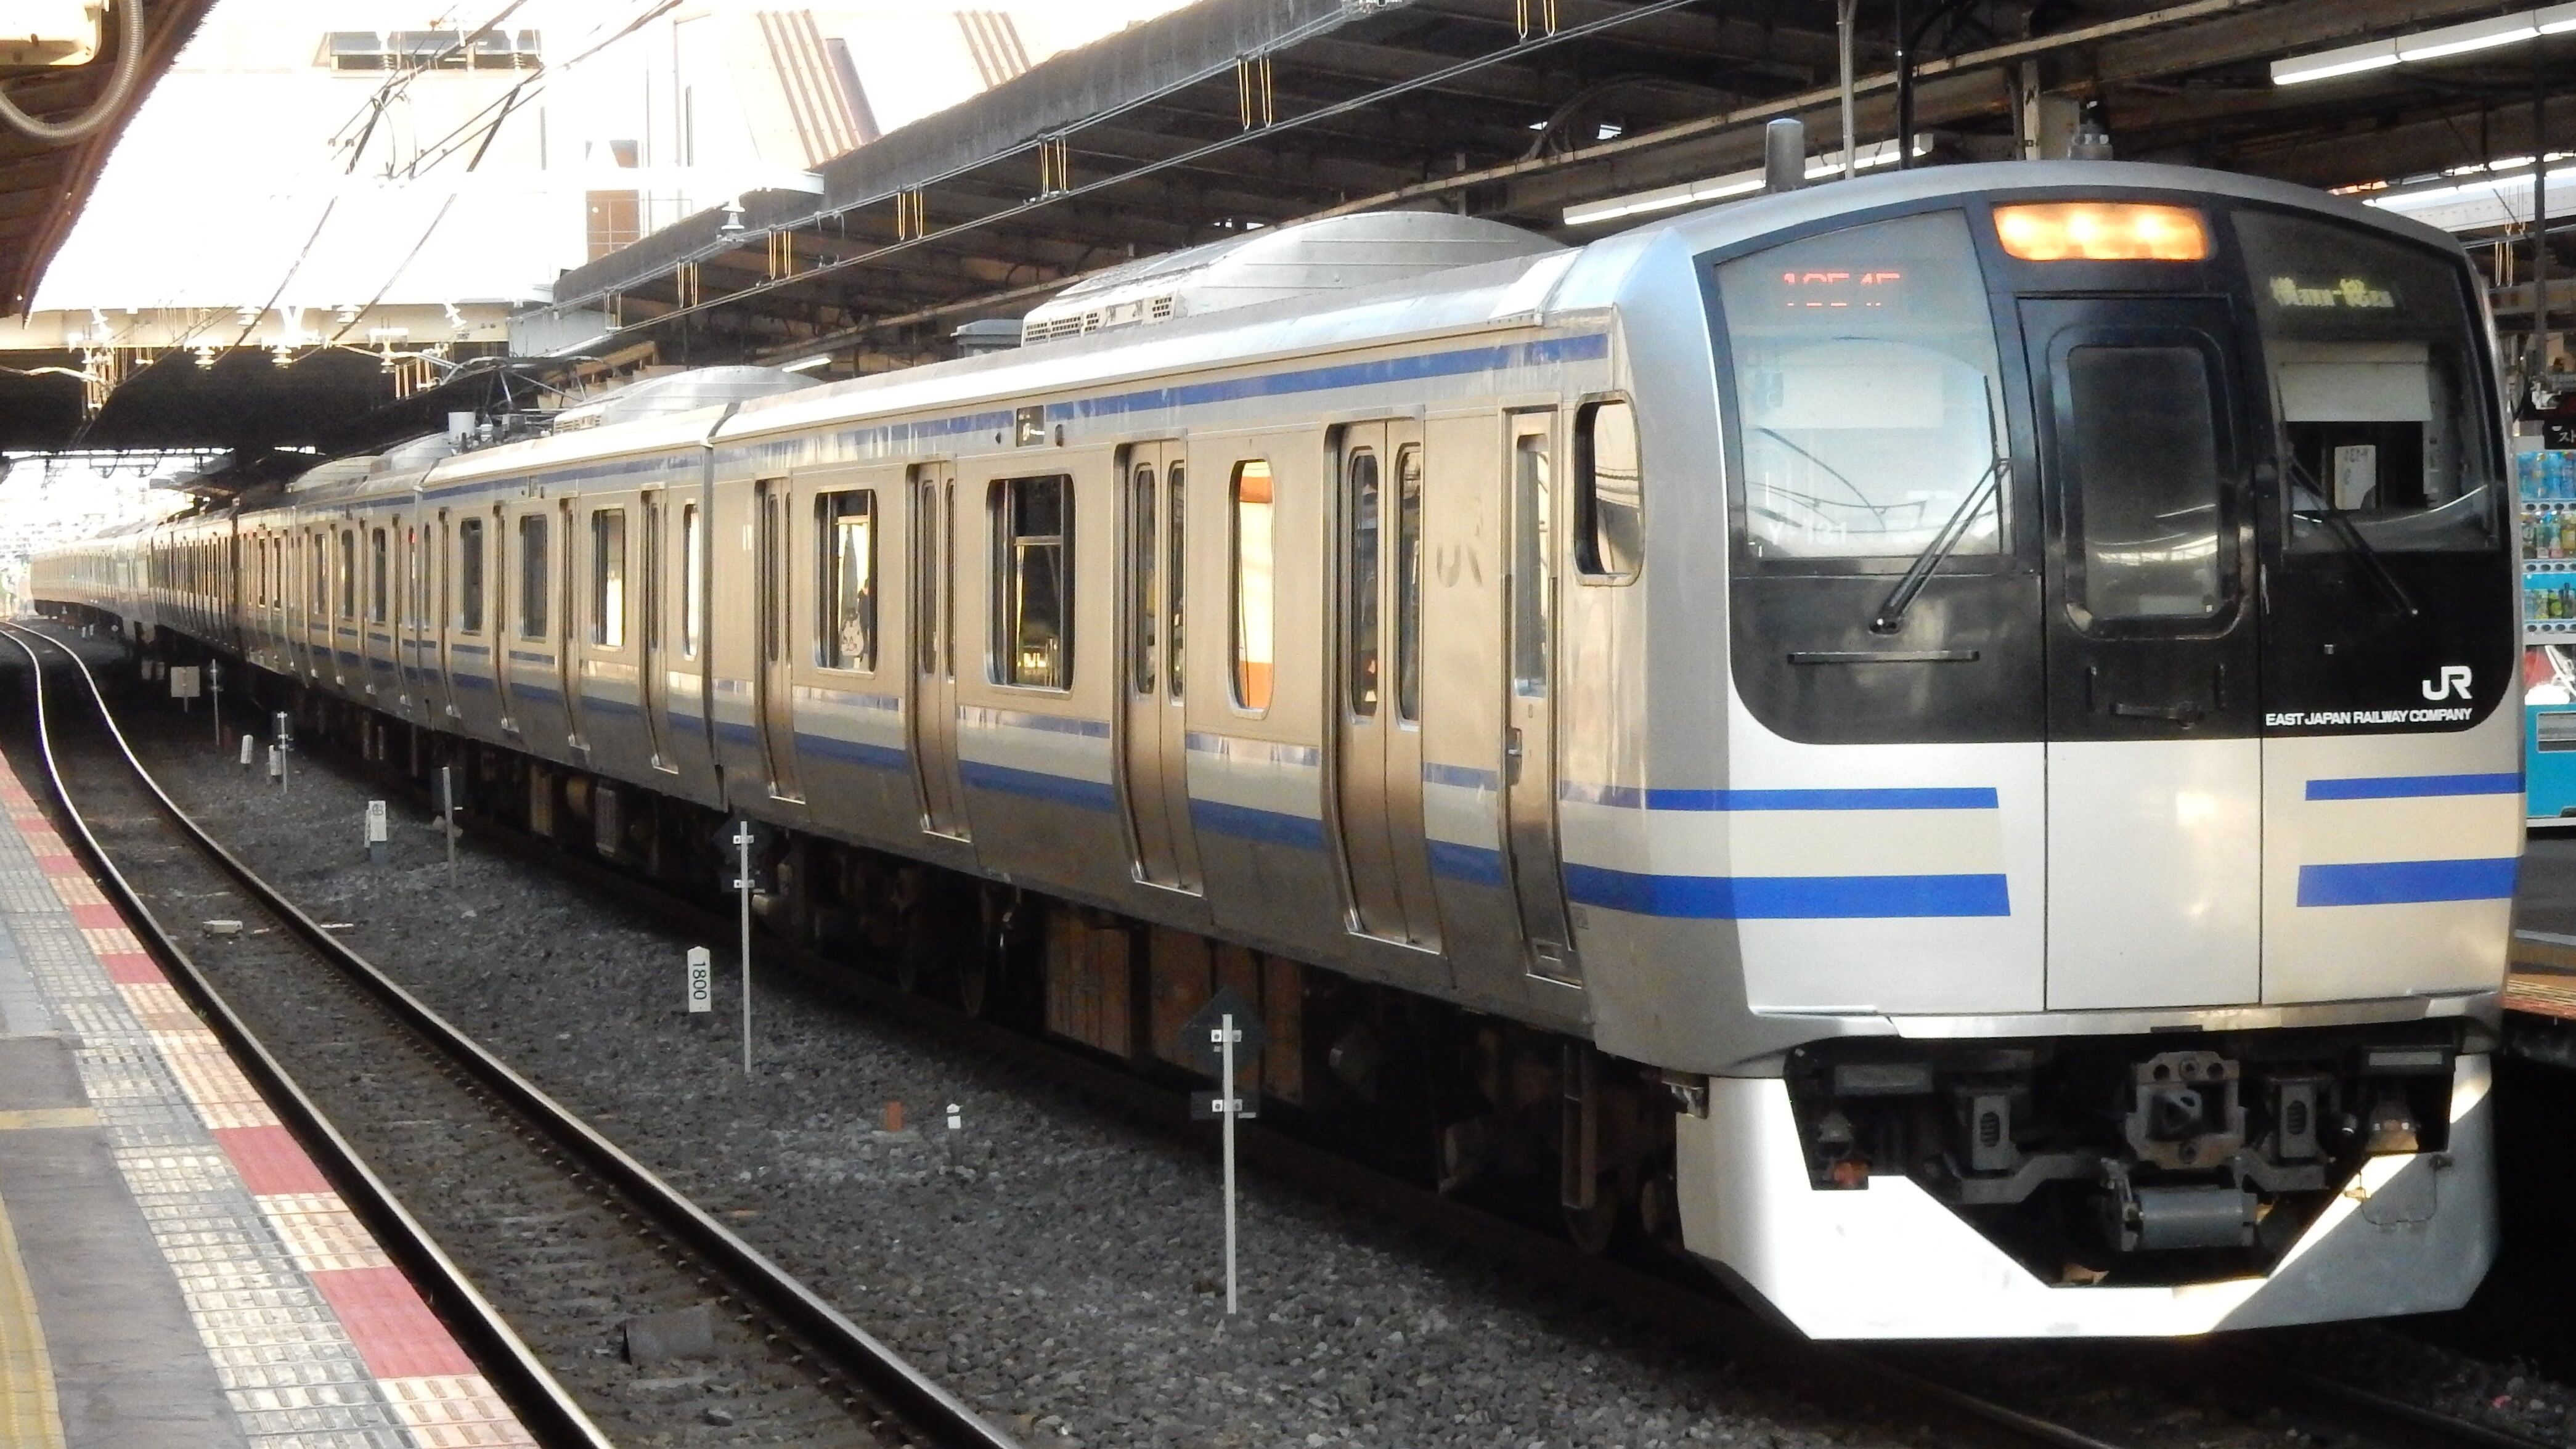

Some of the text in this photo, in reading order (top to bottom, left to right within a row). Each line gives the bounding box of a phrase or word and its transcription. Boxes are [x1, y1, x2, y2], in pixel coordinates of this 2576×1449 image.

[2422, 666, 2472, 701] JR
[2265, 708, 2472, 726] EAST JAPAN RAILWAY COMPANY
[692, 961, 707, 1000] 1800
